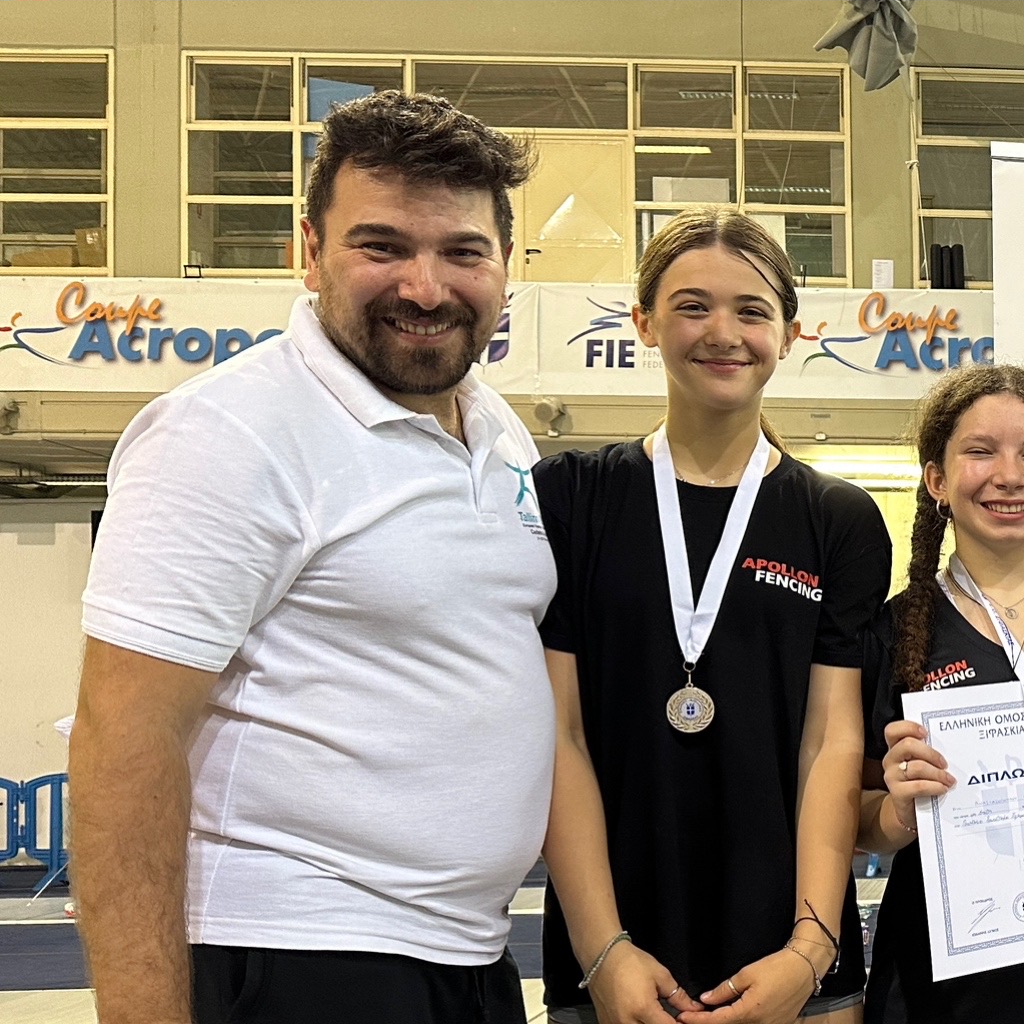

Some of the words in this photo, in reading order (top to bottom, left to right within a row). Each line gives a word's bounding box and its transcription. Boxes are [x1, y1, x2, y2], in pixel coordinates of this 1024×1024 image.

[55, 281, 163, 336] Coupe
[858, 291, 960, 345] Coupe
[586, 339, 635, 368] FIE
[742, 557, 819, 588] APOLLON
[755, 570, 823, 602] FENCING
[922, 667, 976, 692] ENCING
[939, 715, 992, 732] ΕΛΛΗΝΙΚΗ
